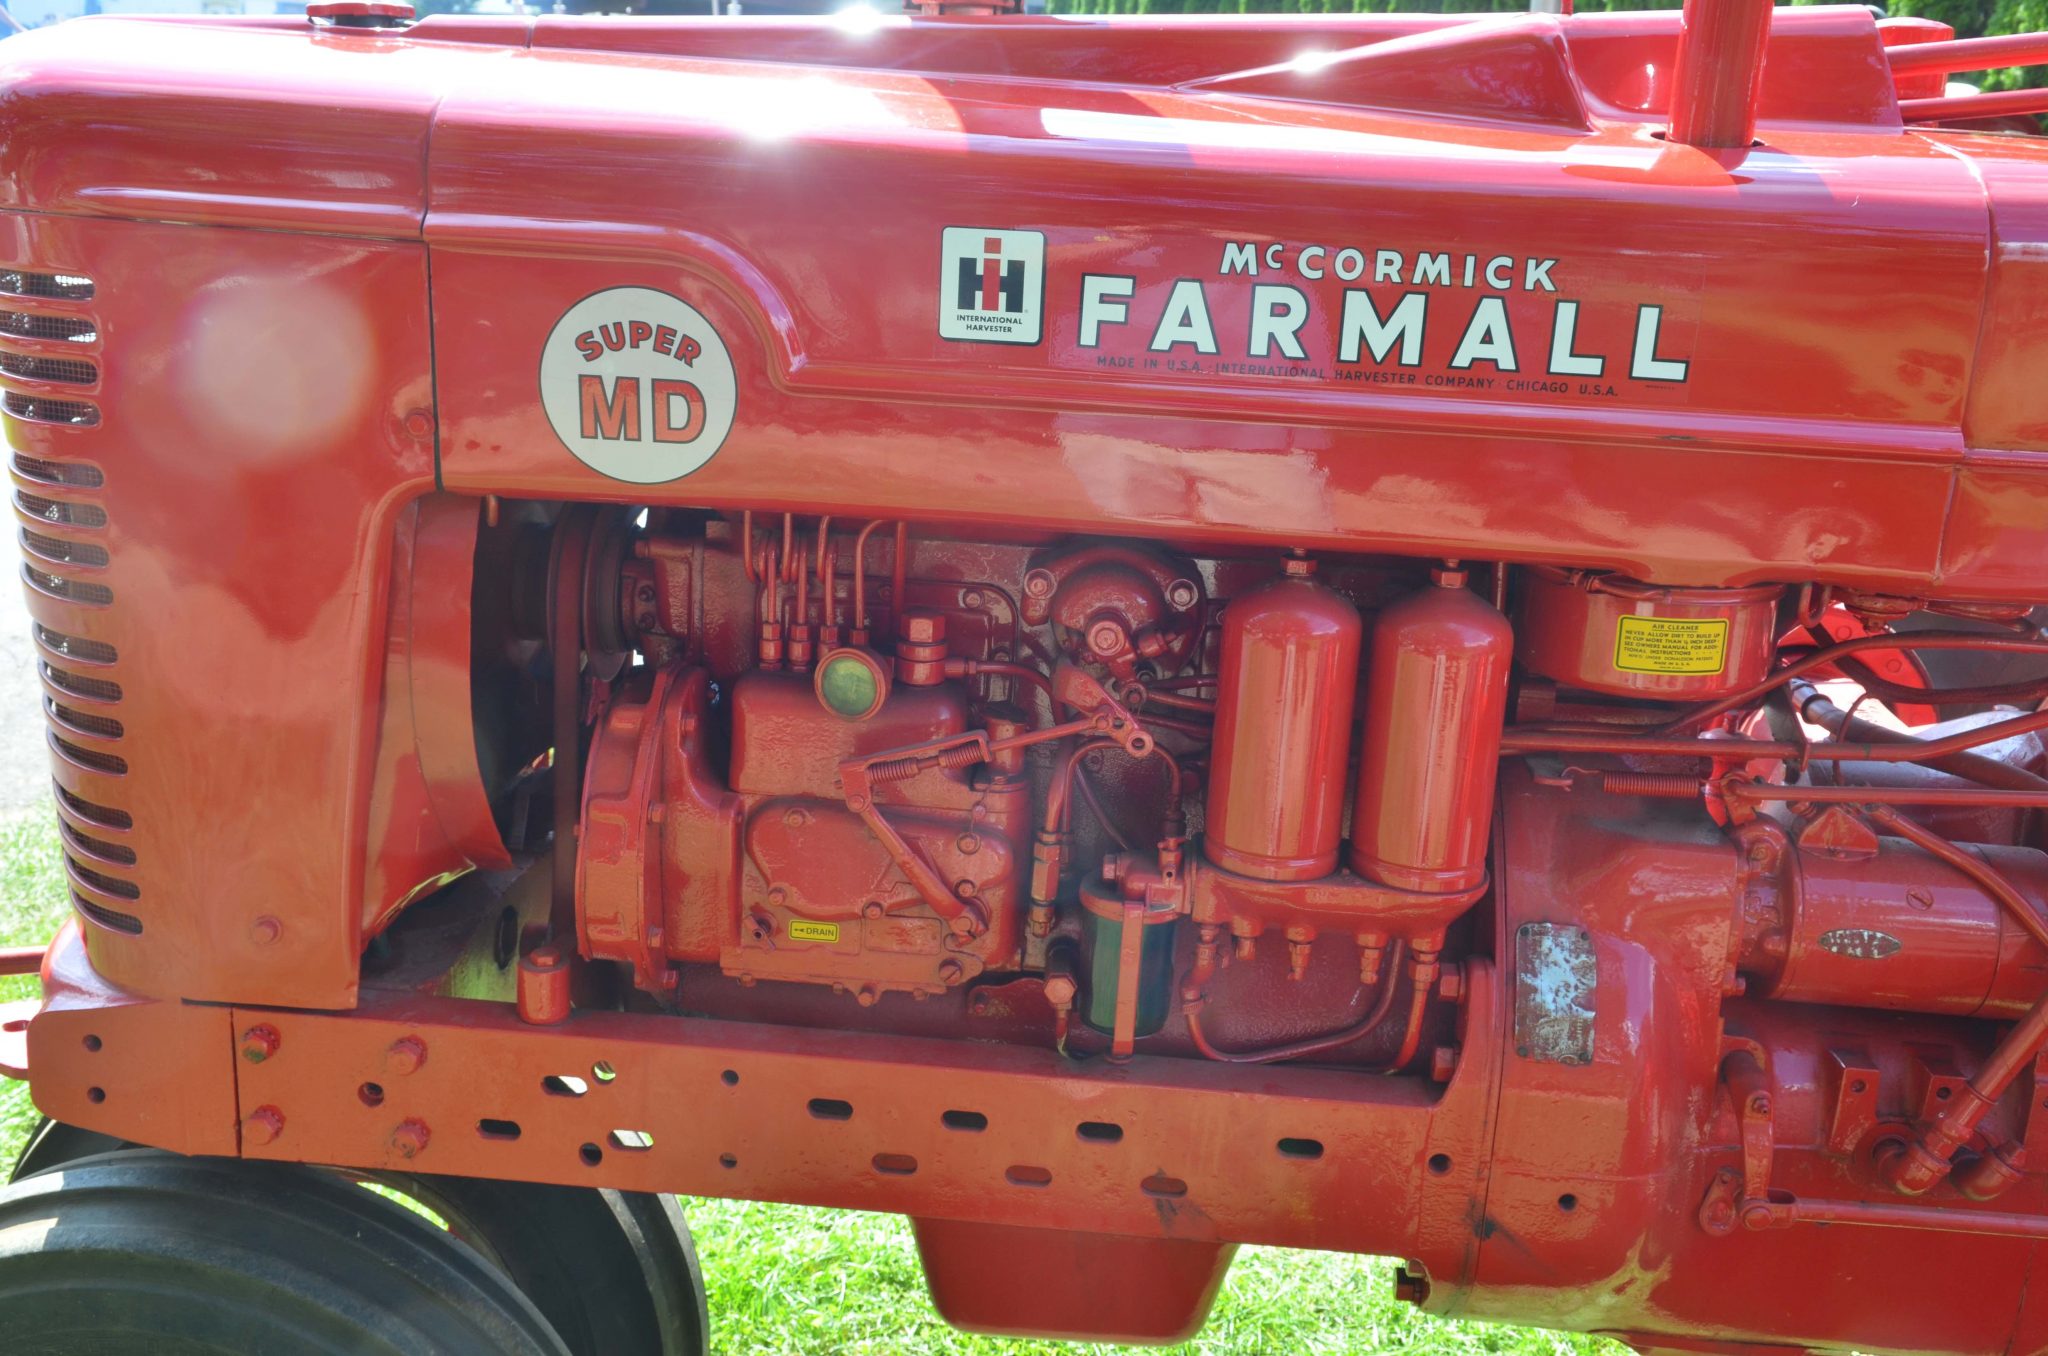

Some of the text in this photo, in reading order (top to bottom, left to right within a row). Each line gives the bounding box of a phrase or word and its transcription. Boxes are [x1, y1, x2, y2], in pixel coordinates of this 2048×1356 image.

[956, 314, 1023, 325] INTERNATIONAL
[966, 324, 1013, 333] HARVESTER
[1077, 272, 1690, 383] FARMALL
[574, 320, 702, 368] SUPER
[1097, 356, 1135, 368] MADE
[1144, 358, 1158, 369] IN
[1216, 362, 1326, 380] INTERNATIONAL
[1335, 370, 1416, 385] HARVESTER
[1425, 374, 1495, 389] COMPANY
[1507, 379, 1568, 393] CHICAGO
[1579, 385, 1618, 397] U.S.A.
[578, 374, 707, 444] MD
[806, 927, 834, 937] DRAIN
